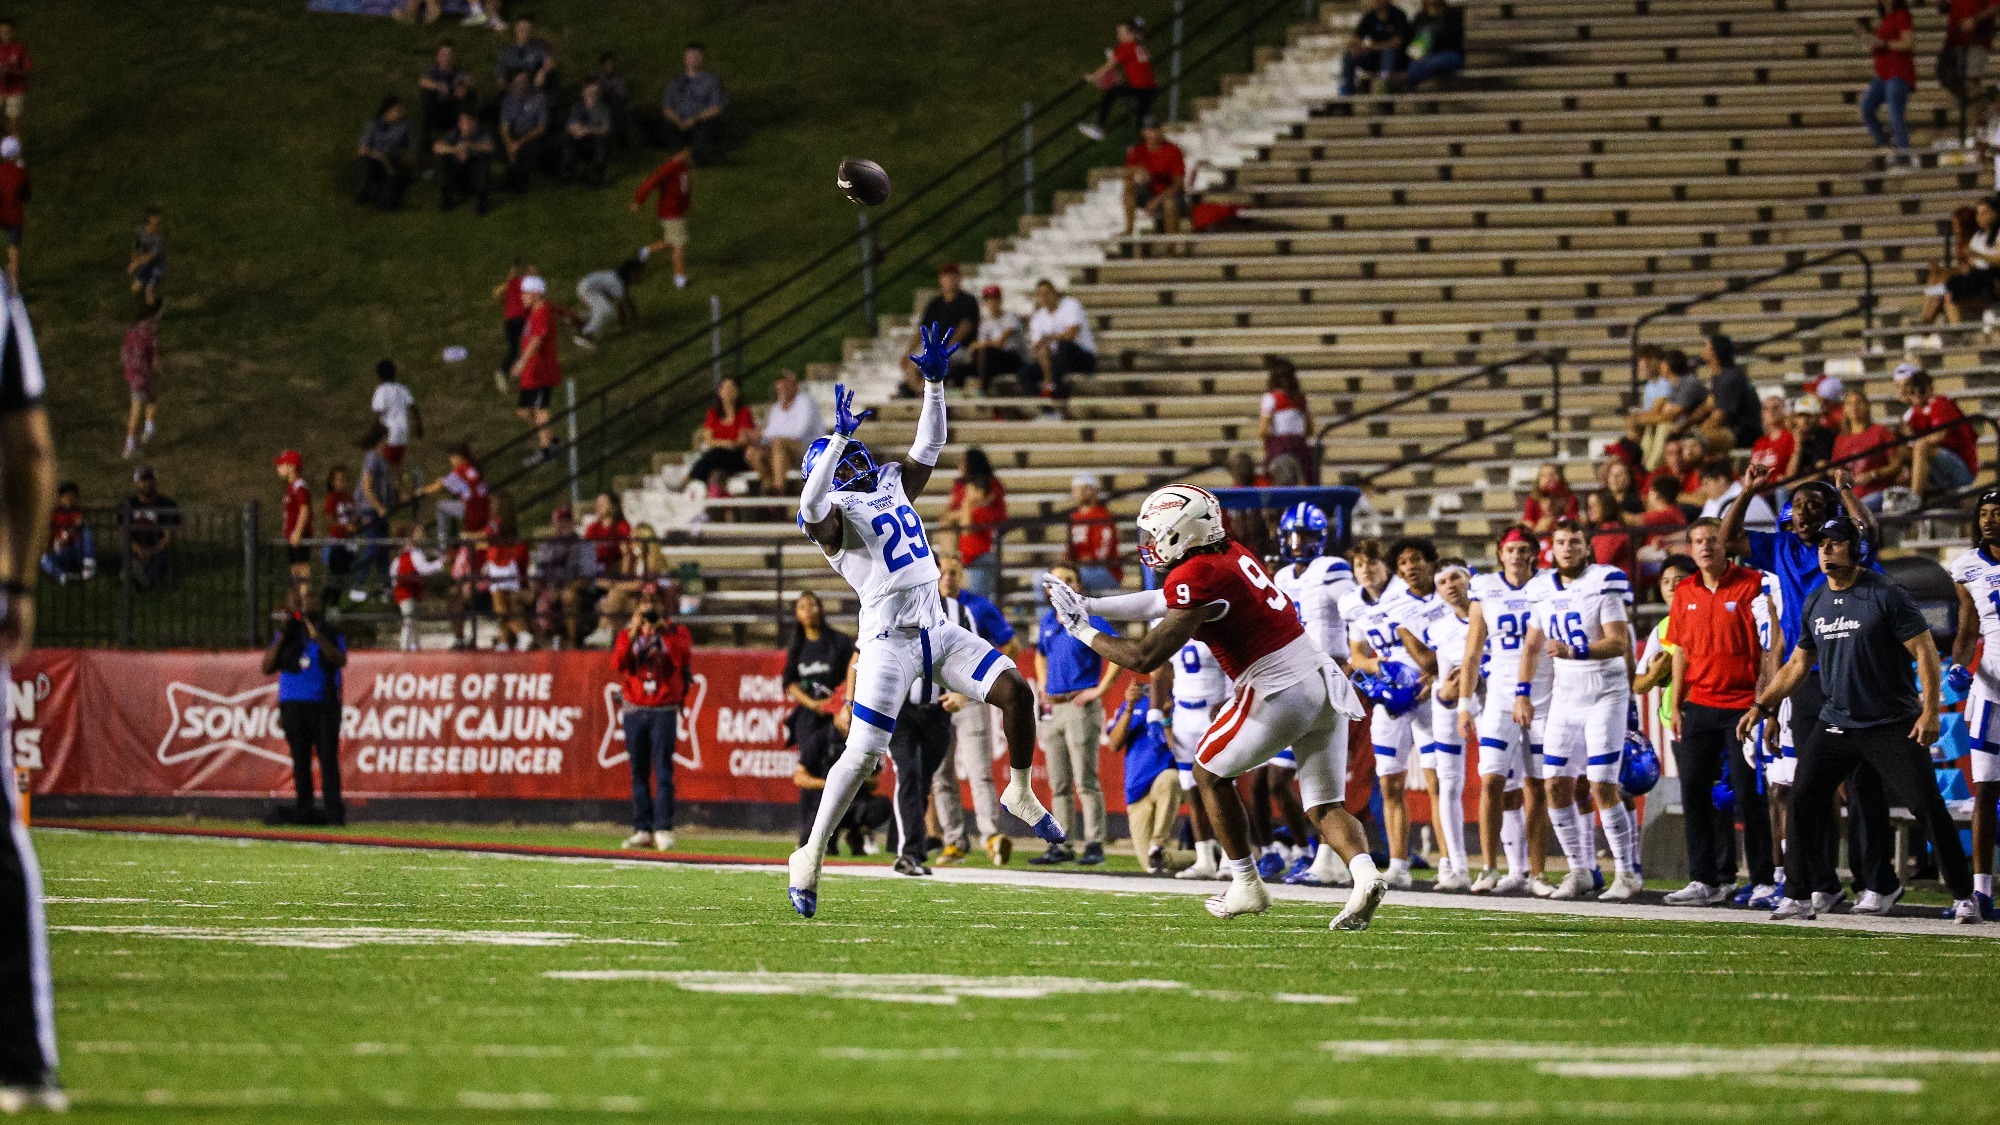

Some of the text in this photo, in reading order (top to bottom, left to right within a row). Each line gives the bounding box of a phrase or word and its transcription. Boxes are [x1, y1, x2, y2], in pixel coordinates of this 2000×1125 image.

[866, 494, 894, 507] GEORGIA
[874, 499, 895, 511] STATE
[871, 504, 929, 574] 29
[1176, 583, 1191, 604] 9
[1237, 555, 1287, 611] 9
[1549, 611, 1589, 649] 46
[1814, 615, 1861, 636] Panthers
[1181, 645, 1201, 673] 0
[374, 673, 554, 700] HOME OF THE
[340, 702, 454, 740] RAGIN'
[356, 745, 564, 774] CHEESEBURGER
